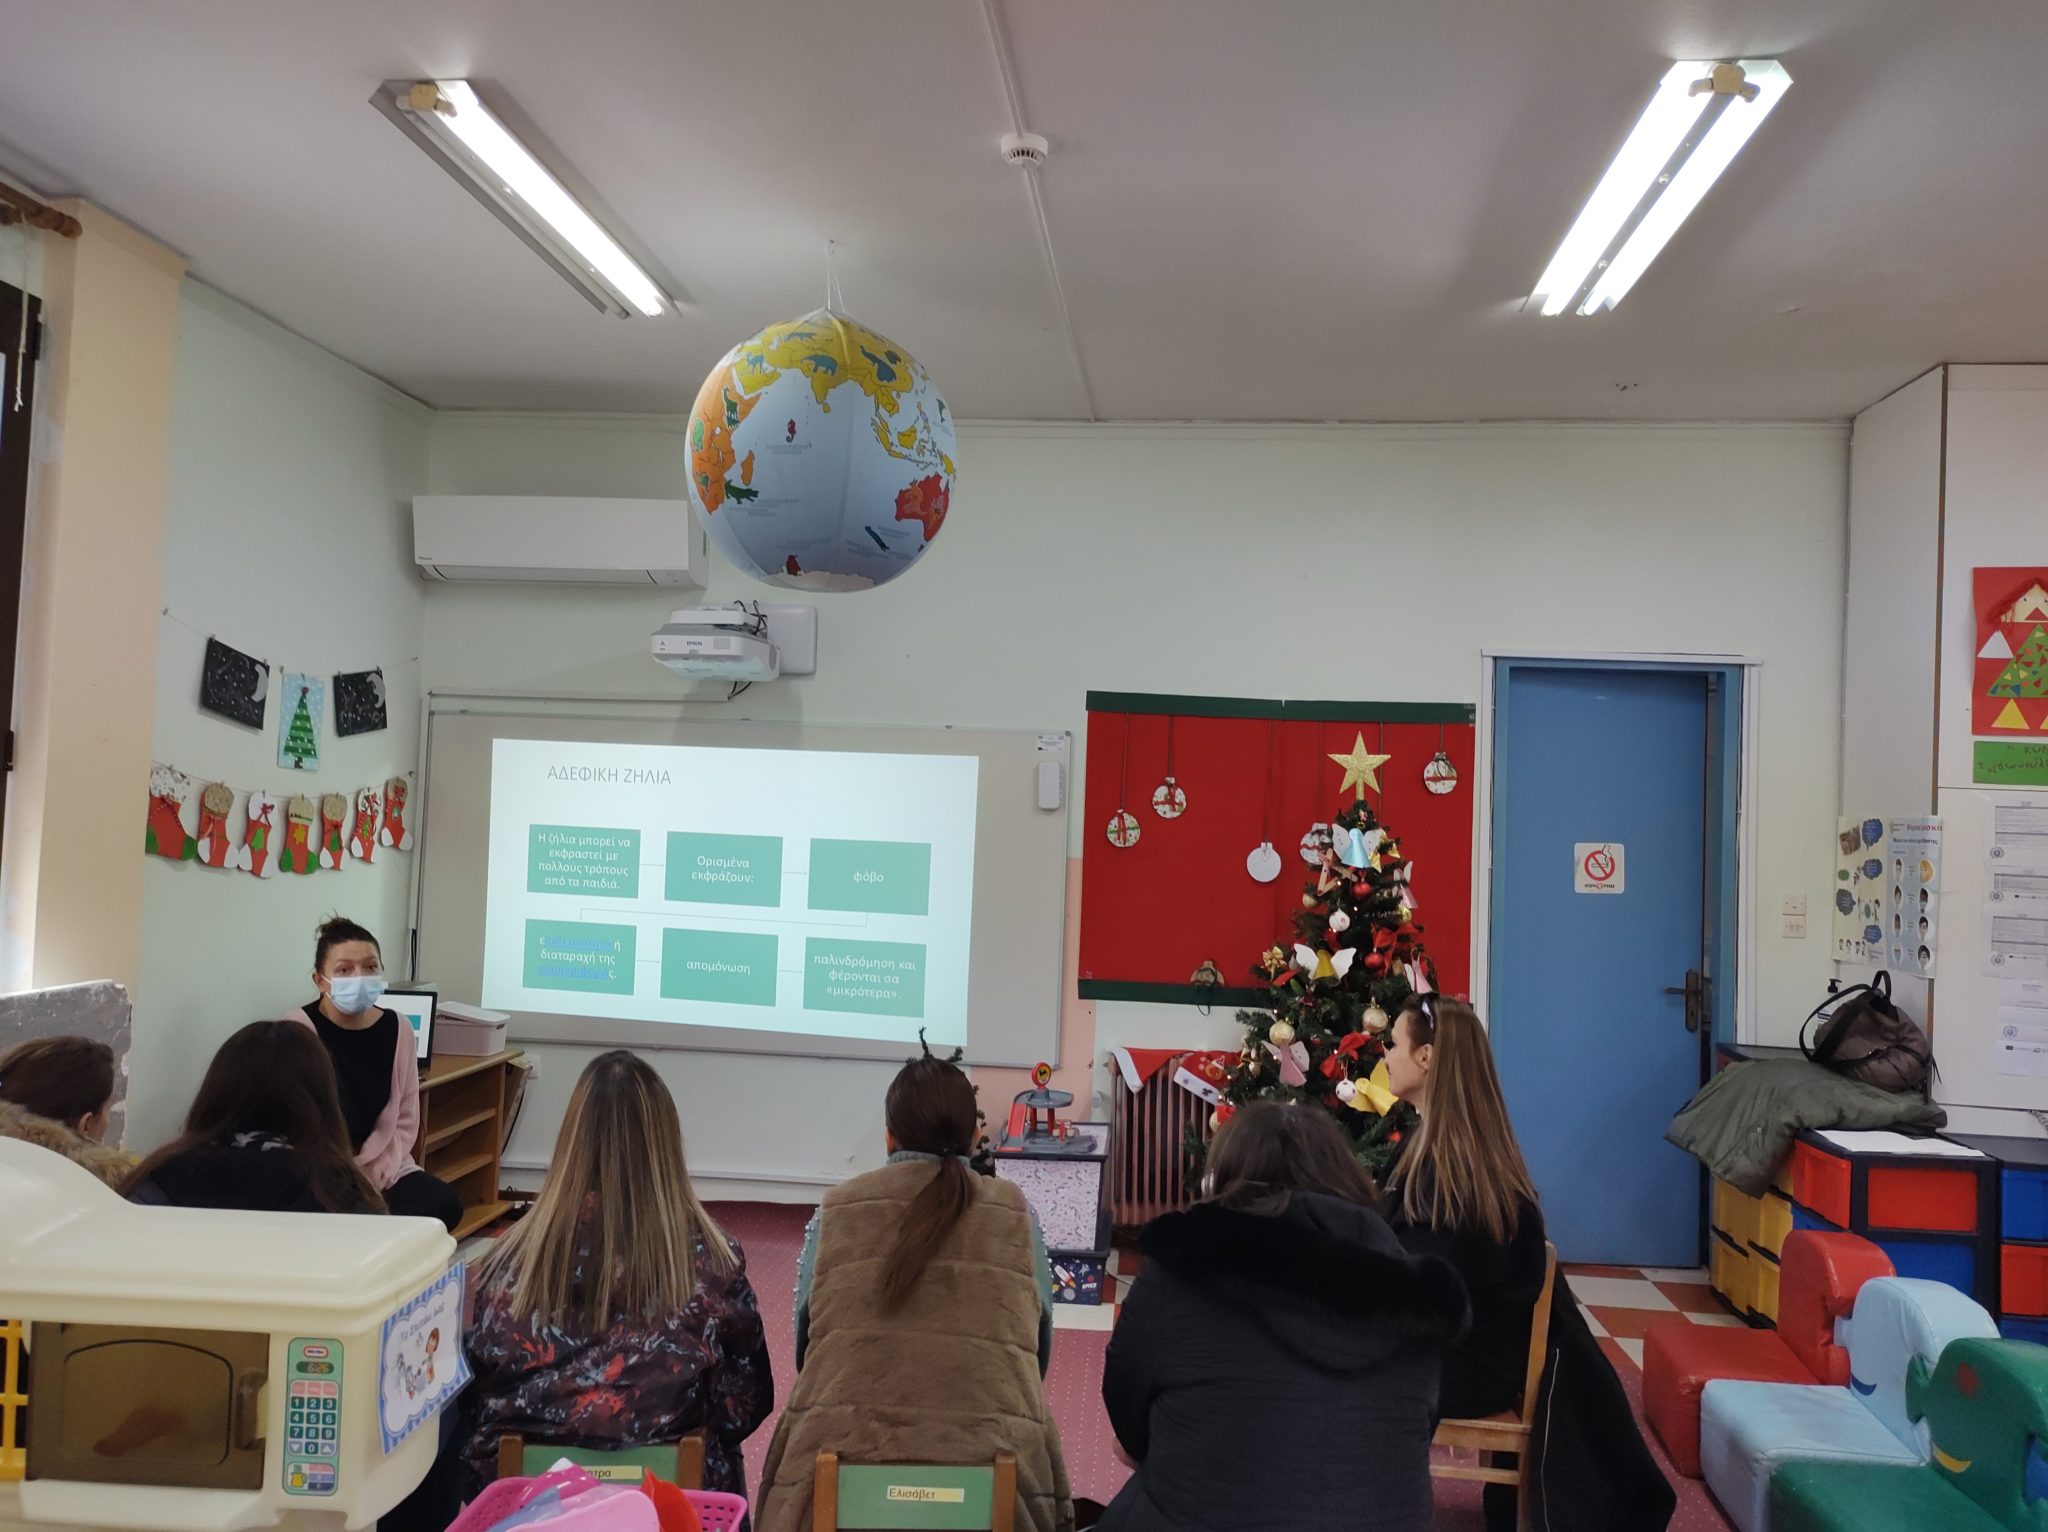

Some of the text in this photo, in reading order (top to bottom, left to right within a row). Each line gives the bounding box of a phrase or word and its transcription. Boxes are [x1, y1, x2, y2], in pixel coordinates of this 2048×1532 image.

[547, 765, 672, 784] ΑΔΕΦΙΚΗ ΖΗΛΙΑ
[538, 833, 631, 848] Η ζήλια μπορεί να
[549, 848, 619, 863] εκφραστεί με
[697, 855, 750, 870] Ορισμένα
[538, 861, 629, 877] πολλούς τρόπους
[544, 875, 621, 889] από τα παιδιά.
[691, 870, 754, 884] εκφράζουν:
[853, 870, 884, 884] φόβο
[614, 939, 621, 952] ή
[540, 949, 616, 966] διαταραχή της
[814, 954, 917, 971] παλινδρόμηση και
[686, 960, 751, 975] απομόνωση
[828, 968, 900, 984] φέρονται σα
[826, 984, 901, 999] «μικρότερα».
[294, 1398, 333, 1409] 1 2 3
[293, 1413, 332, 1424] 4 5 6
[293, 1428, 332, 1439] 7 8 9
[308, 1444, 315, 1453] 0
[889, 1488, 936, 1500] Ελισάβετ
